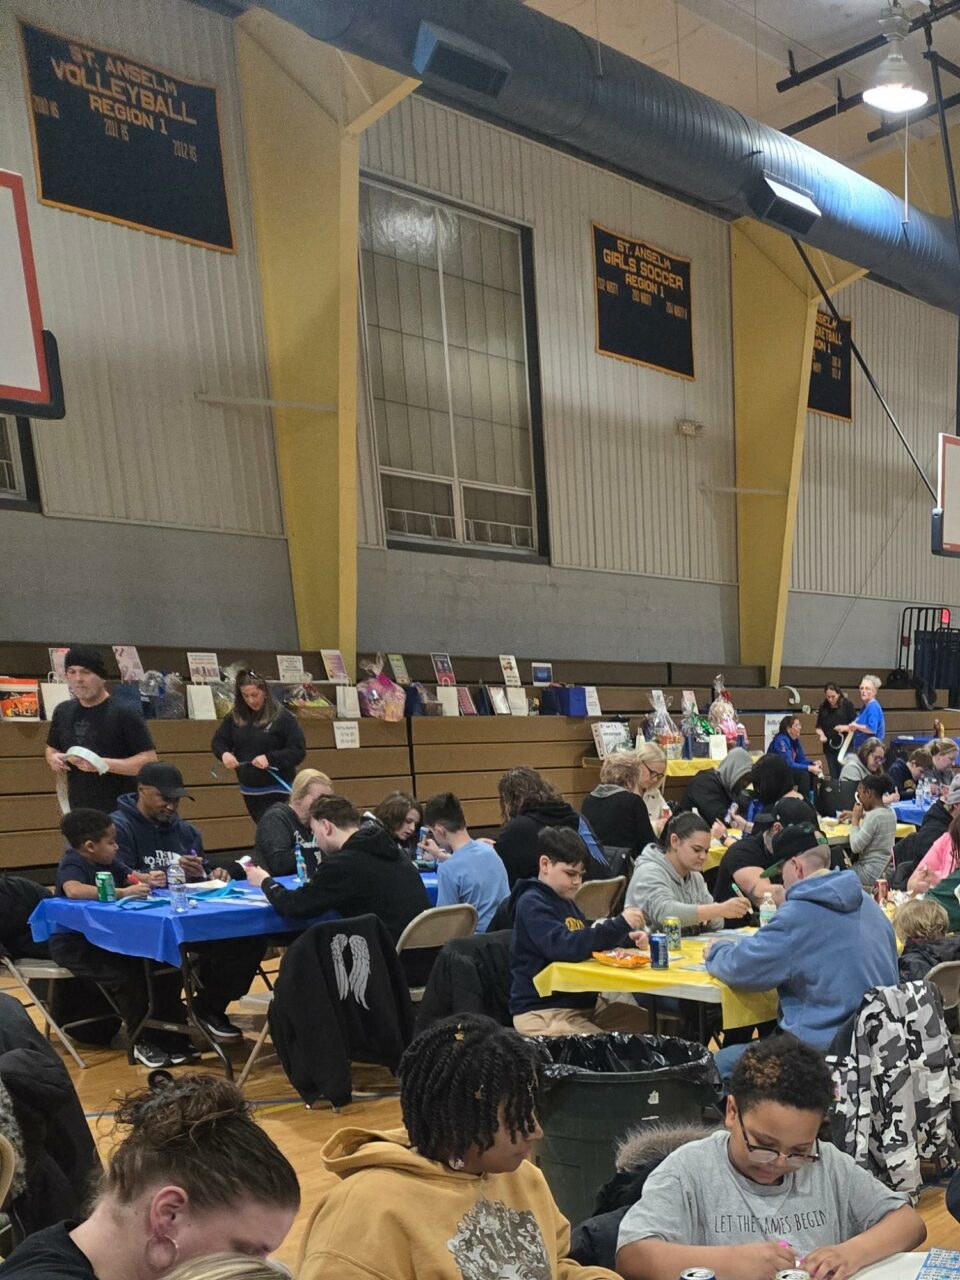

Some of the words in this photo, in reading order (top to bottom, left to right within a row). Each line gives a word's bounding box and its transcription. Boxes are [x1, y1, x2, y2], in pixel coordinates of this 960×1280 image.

[51, 57, 197, 124] VOLLEYBALL
[106, 57, 177, 96] ANSELM
[89, 94, 155, 130] REGION
[159, 118, 168, 135] 1
[603, 248, 637, 273] GIRLS
[640, 261, 683, 291] SOCCER
[617, 240, 632, 255] ST.
[635, 245, 671, 270] ANSELM
[625, 273, 658, 295] REGION
[660, 285, 665, 298] 1
[714, 1215, 732, 1233] LET
[738, 1215, 757, 1233] THE
[762, 1216, 792, 1236] AMES
[793, 1210, 827, 1232] BEGIN
